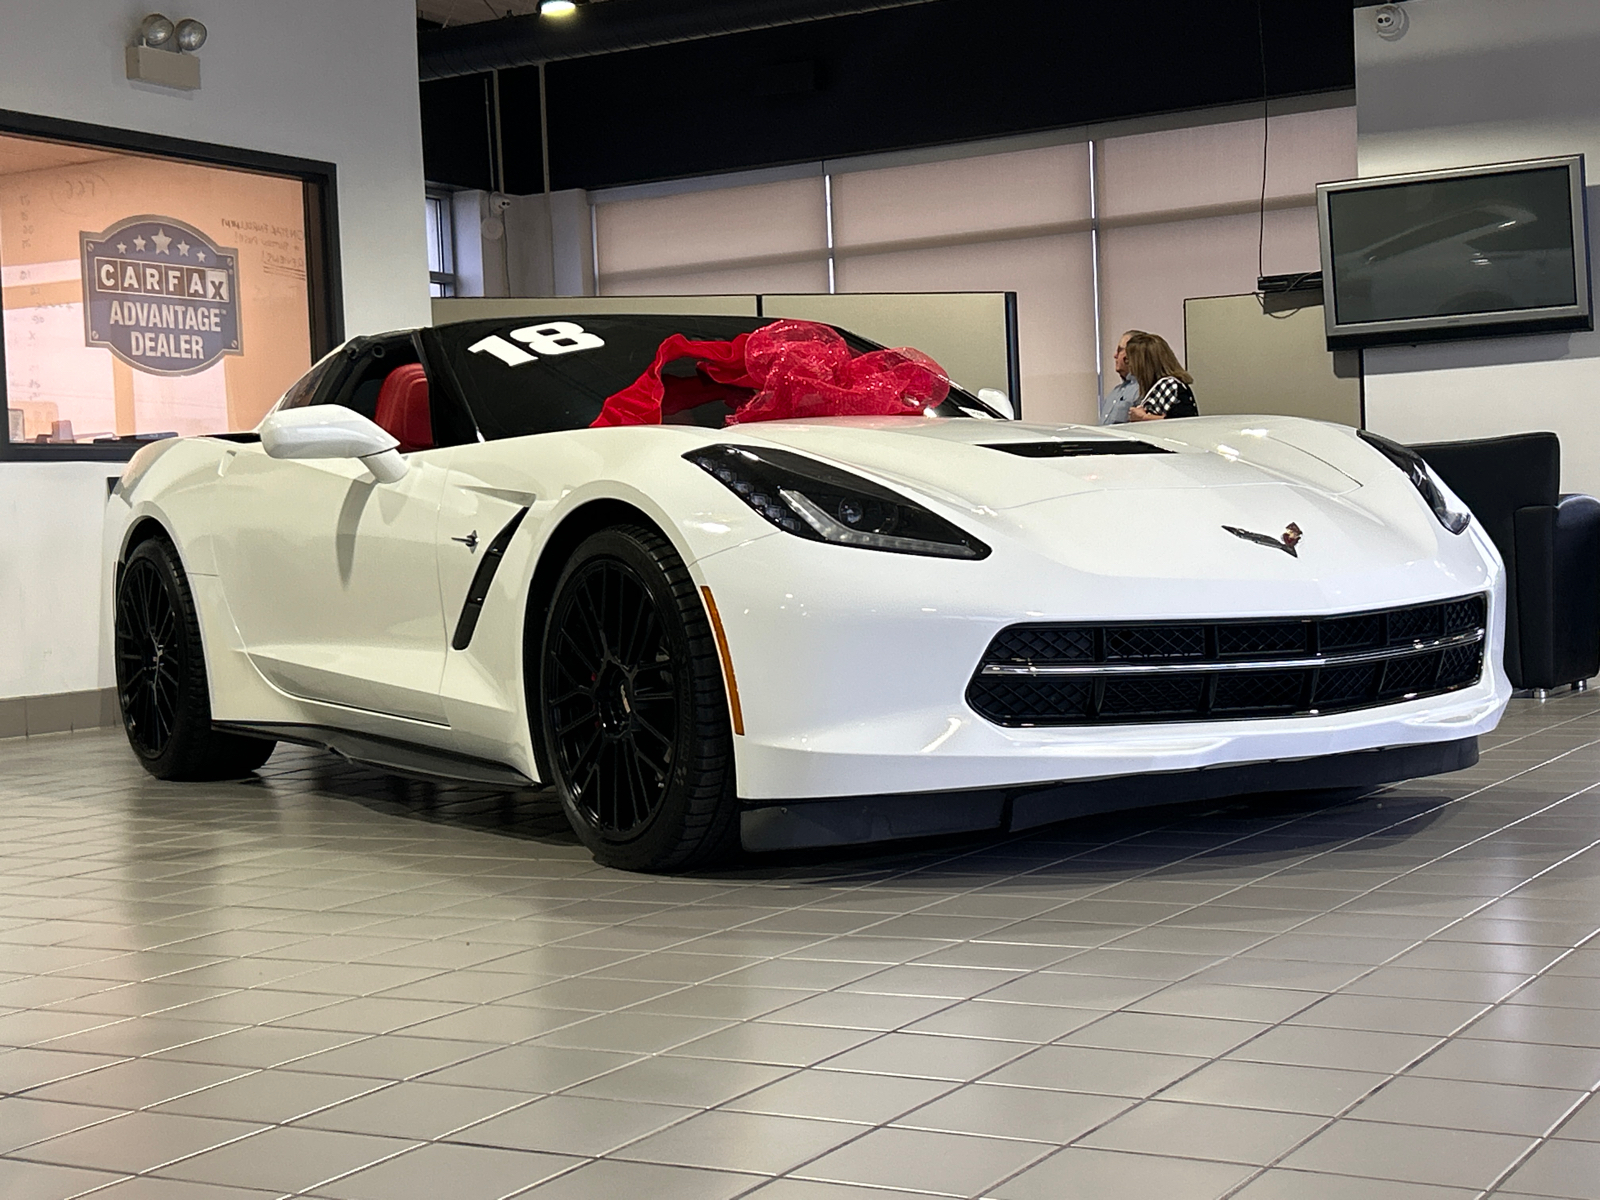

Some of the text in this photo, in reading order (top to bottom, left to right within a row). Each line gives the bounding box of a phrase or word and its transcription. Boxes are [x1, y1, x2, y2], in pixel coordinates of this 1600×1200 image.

[100, 263, 226, 301] CARFAX
[130, 331, 205, 360] DEALER
[467, 321, 605, 367] 18
